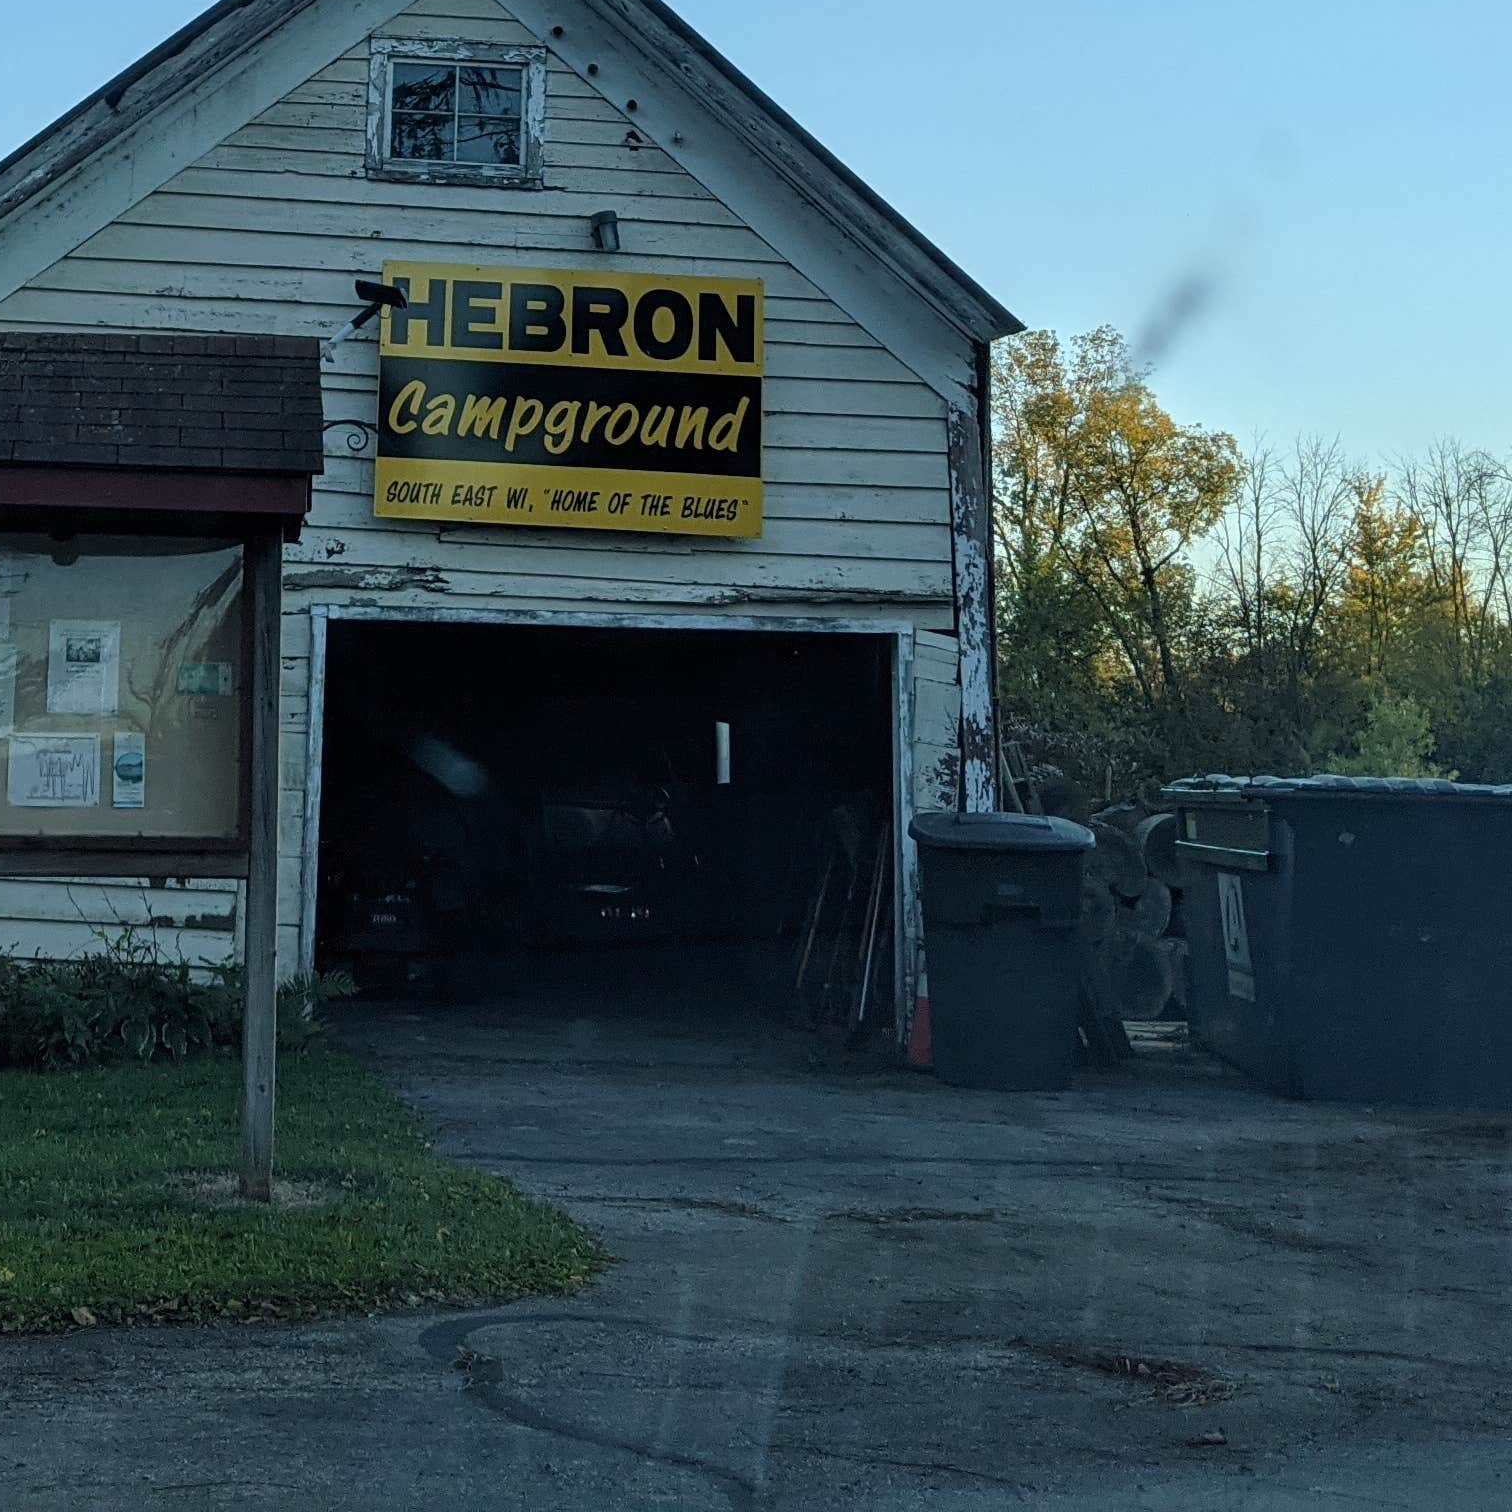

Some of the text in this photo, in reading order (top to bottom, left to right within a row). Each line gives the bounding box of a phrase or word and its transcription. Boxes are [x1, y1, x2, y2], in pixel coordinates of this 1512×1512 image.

[390, 277, 755, 363] HEBRON
[388, 380, 750, 454] Campground
[386, 481, 748, 520] SOUTH EAST WI, "HOME OF THE BLUES"
